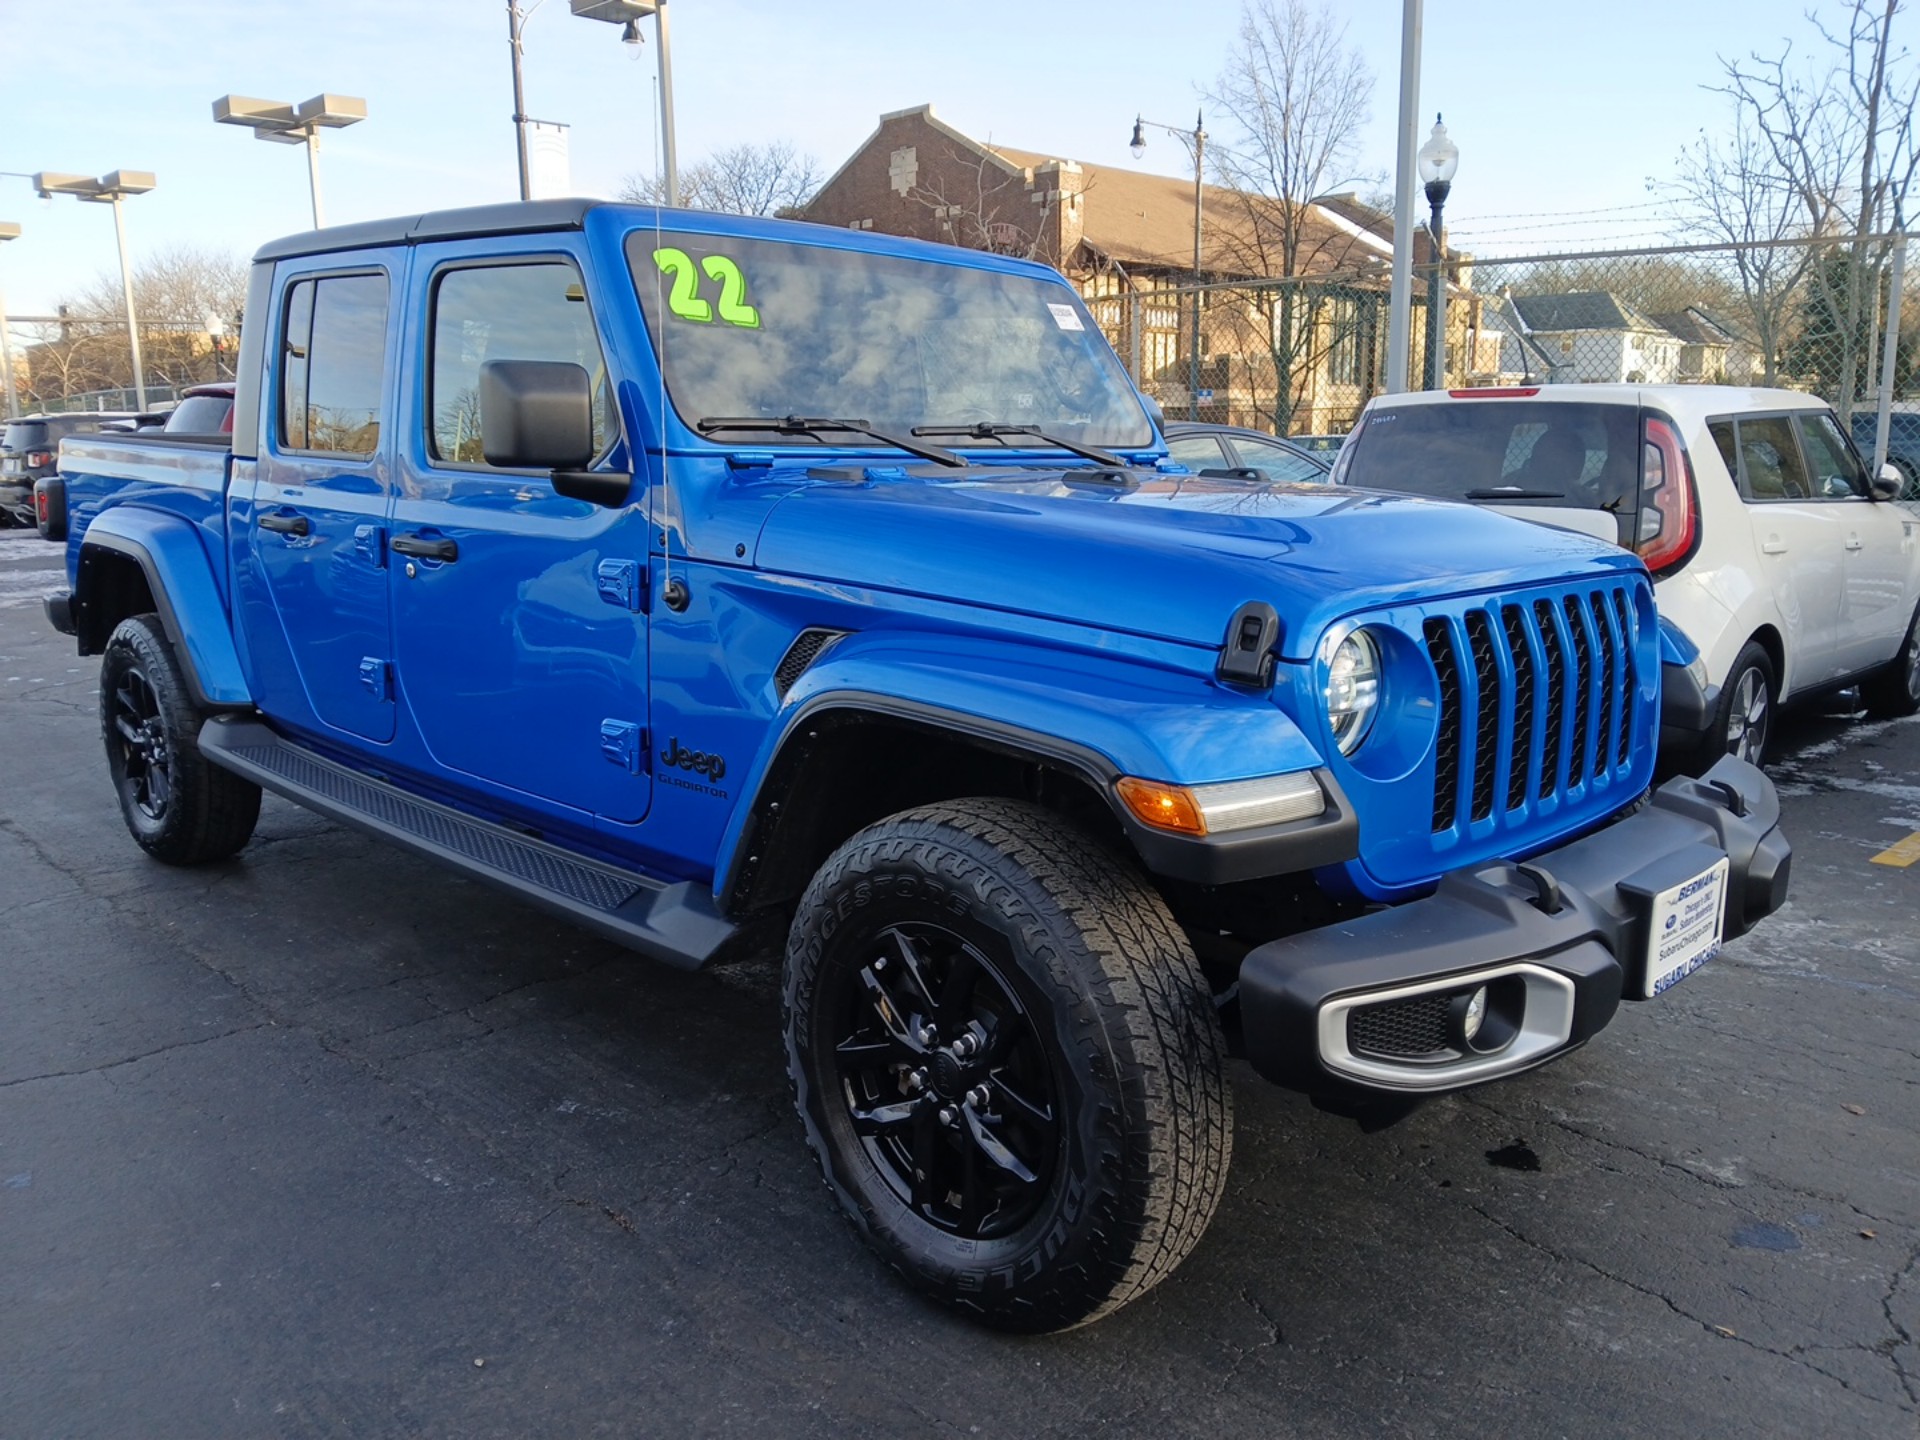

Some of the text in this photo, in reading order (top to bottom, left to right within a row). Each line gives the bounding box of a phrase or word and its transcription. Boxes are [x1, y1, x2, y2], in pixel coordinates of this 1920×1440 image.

[652, 247, 761, 329] 22
[661, 736, 726, 784] Jeep
[658, 772, 728, 800] GLADIATOR
[1653, 961, 1688, 997] SUBARU
